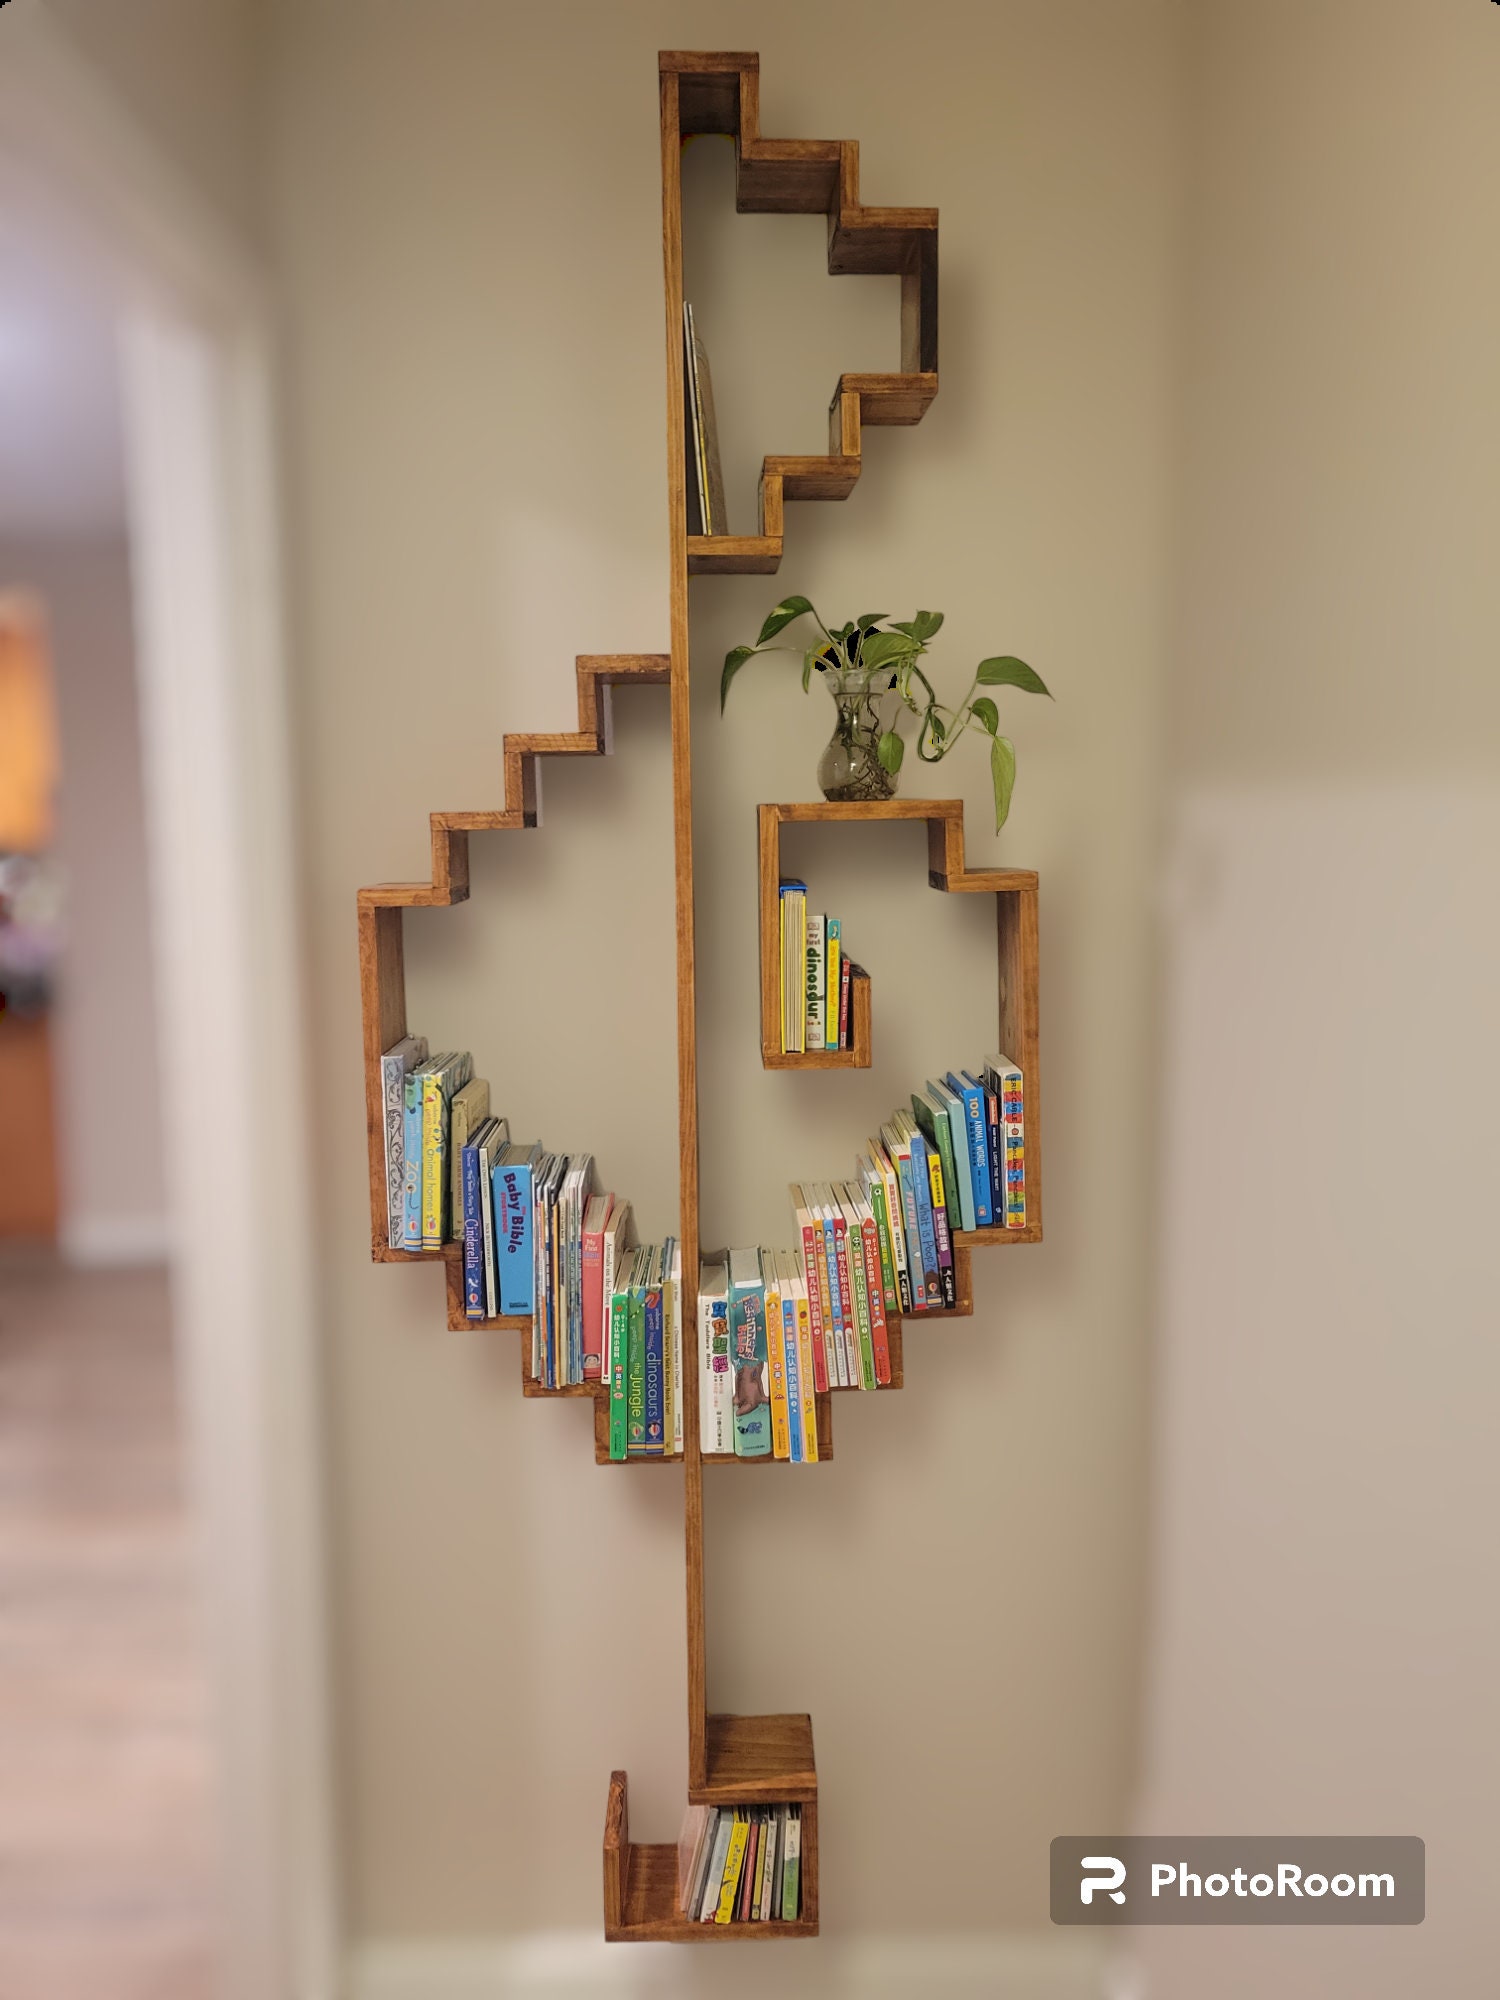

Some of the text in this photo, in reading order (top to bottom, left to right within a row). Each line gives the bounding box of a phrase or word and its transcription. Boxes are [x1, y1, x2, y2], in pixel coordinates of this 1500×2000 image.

[807, 947, 824, 1020] dinosaur
[969, 1097, 980, 1118] 100
[974, 1120, 984, 1142] ANIMAL
[426, 1148, 436, 1211] animal homes
[976, 1144, 986, 1168] WORDS
[504, 1172, 524, 1254] Baby Bible
[906, 1191, 917, 1230] FUTURE
[918, 1202, 936, 1268] What is Poop?
[464, 1219, 479, 1269] Cinderella
[606, 1268, 611, 1277] on
[808, 1270, 820, 1328] 幼儿认知小百科
[828, 1256, 840, 1307] 幼儿认知小百科
[838, 1254, 850, 1306] 幼儿认知小百科
[856, 1268, 868, 1326] 幼儿认知小百科
[736, 1325, 748, 1355] Bible
[629, 1362, 644, 1418] the Jungle
[646, 1352, 661, 1418] dinosaurs
[786, 1342, 798, 1400] 幼儿认知小百科
